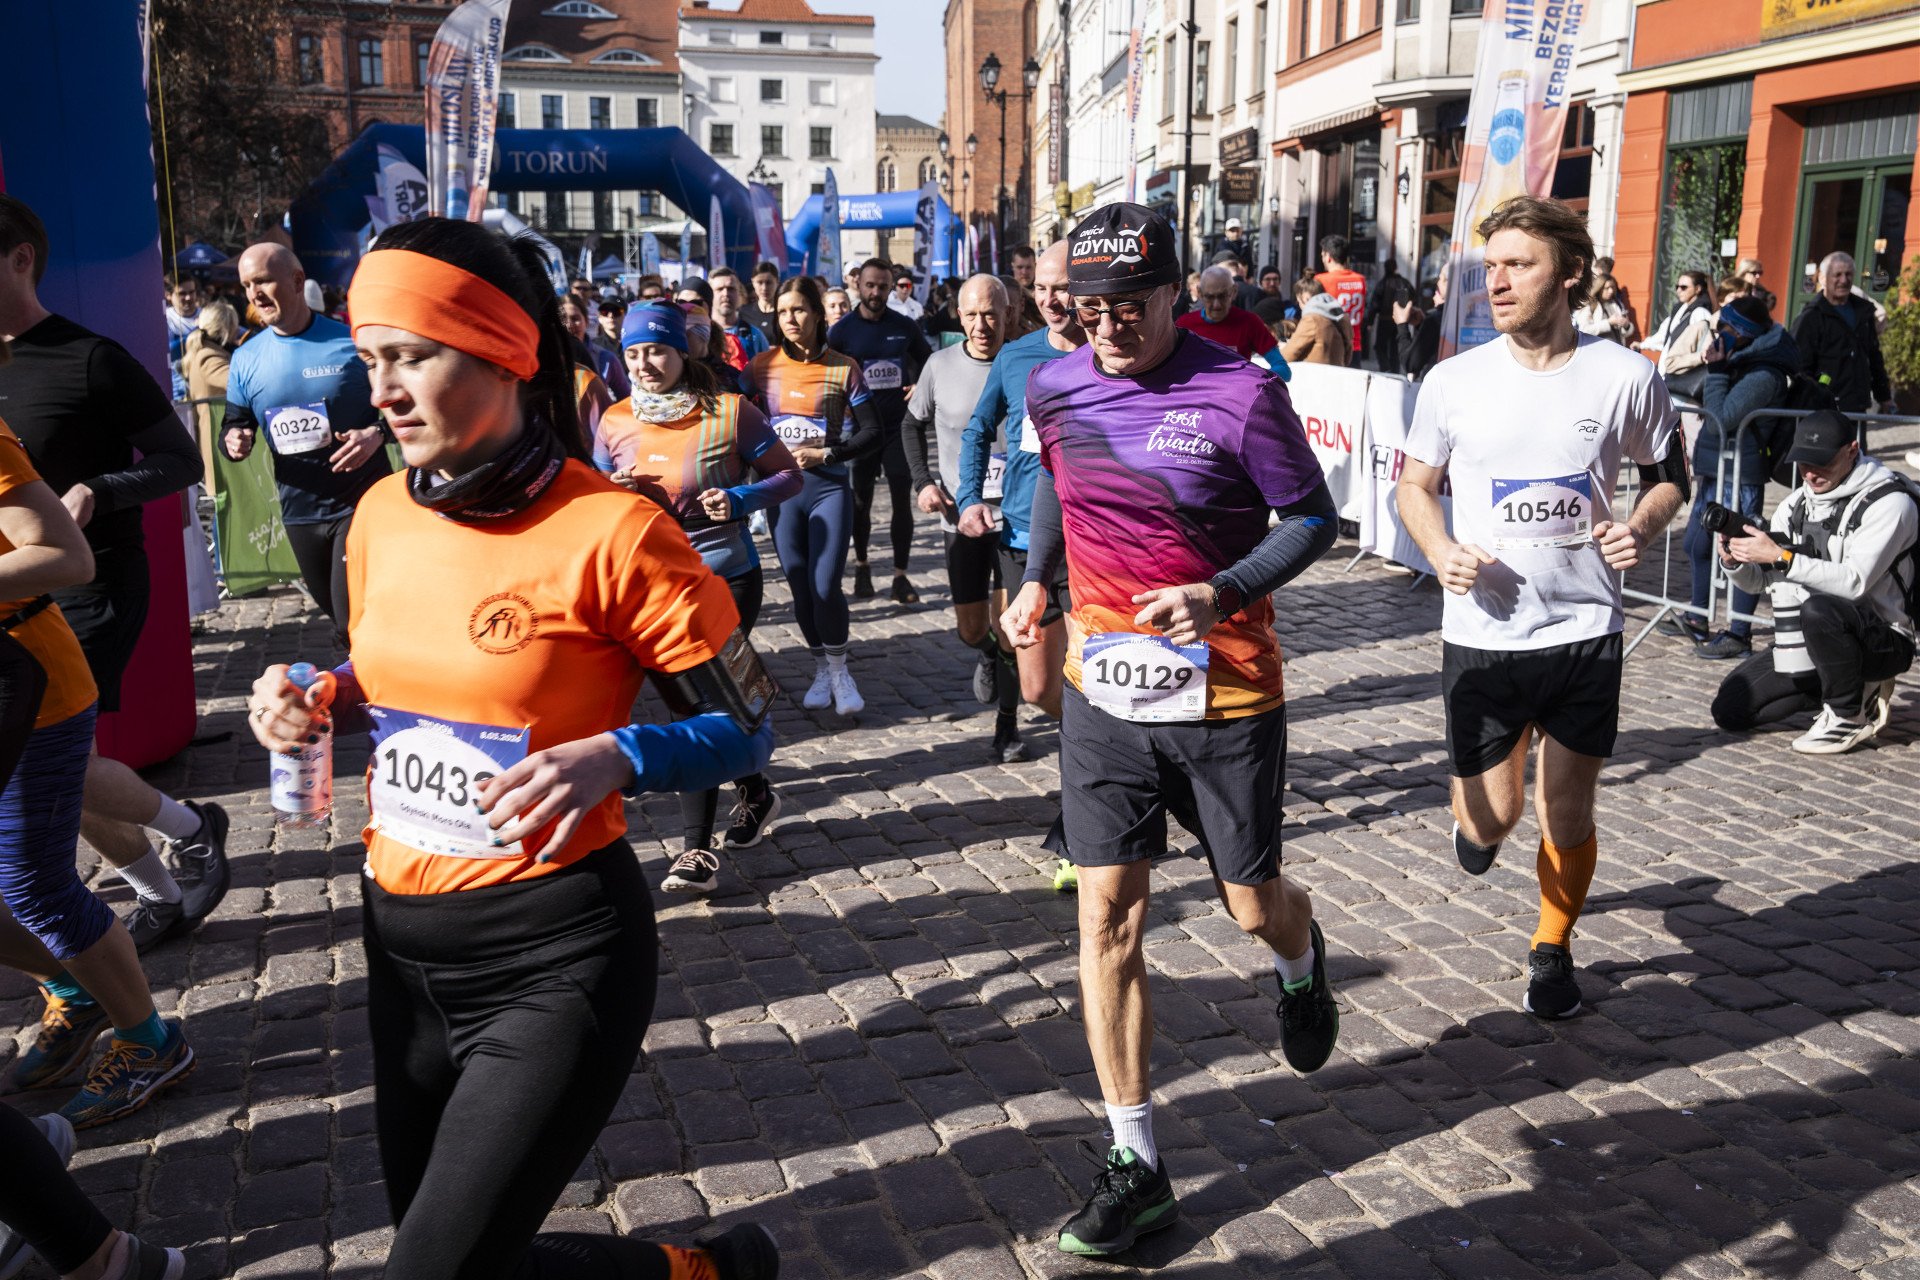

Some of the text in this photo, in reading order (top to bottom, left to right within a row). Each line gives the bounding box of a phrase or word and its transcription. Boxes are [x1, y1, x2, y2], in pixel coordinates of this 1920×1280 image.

[1543, 44, 1574, 110] YERBA
[507, 144, 608, 174] TORUŃ
[1072, 237, 1139, 257] GDYNIA
[868, 367, 898, 379] 10188
[273, 416, 322, 437] 10322
[776, 426, 819, 439] 10313
[1146, 425, 1217, 454] triada
[1306, 416, 1352, 454] RUN
[1578, 426, 1598, 434] PGE
[1502, 496, 1582, 523] 10546
[1095, 658, 1193, 690] 10129
